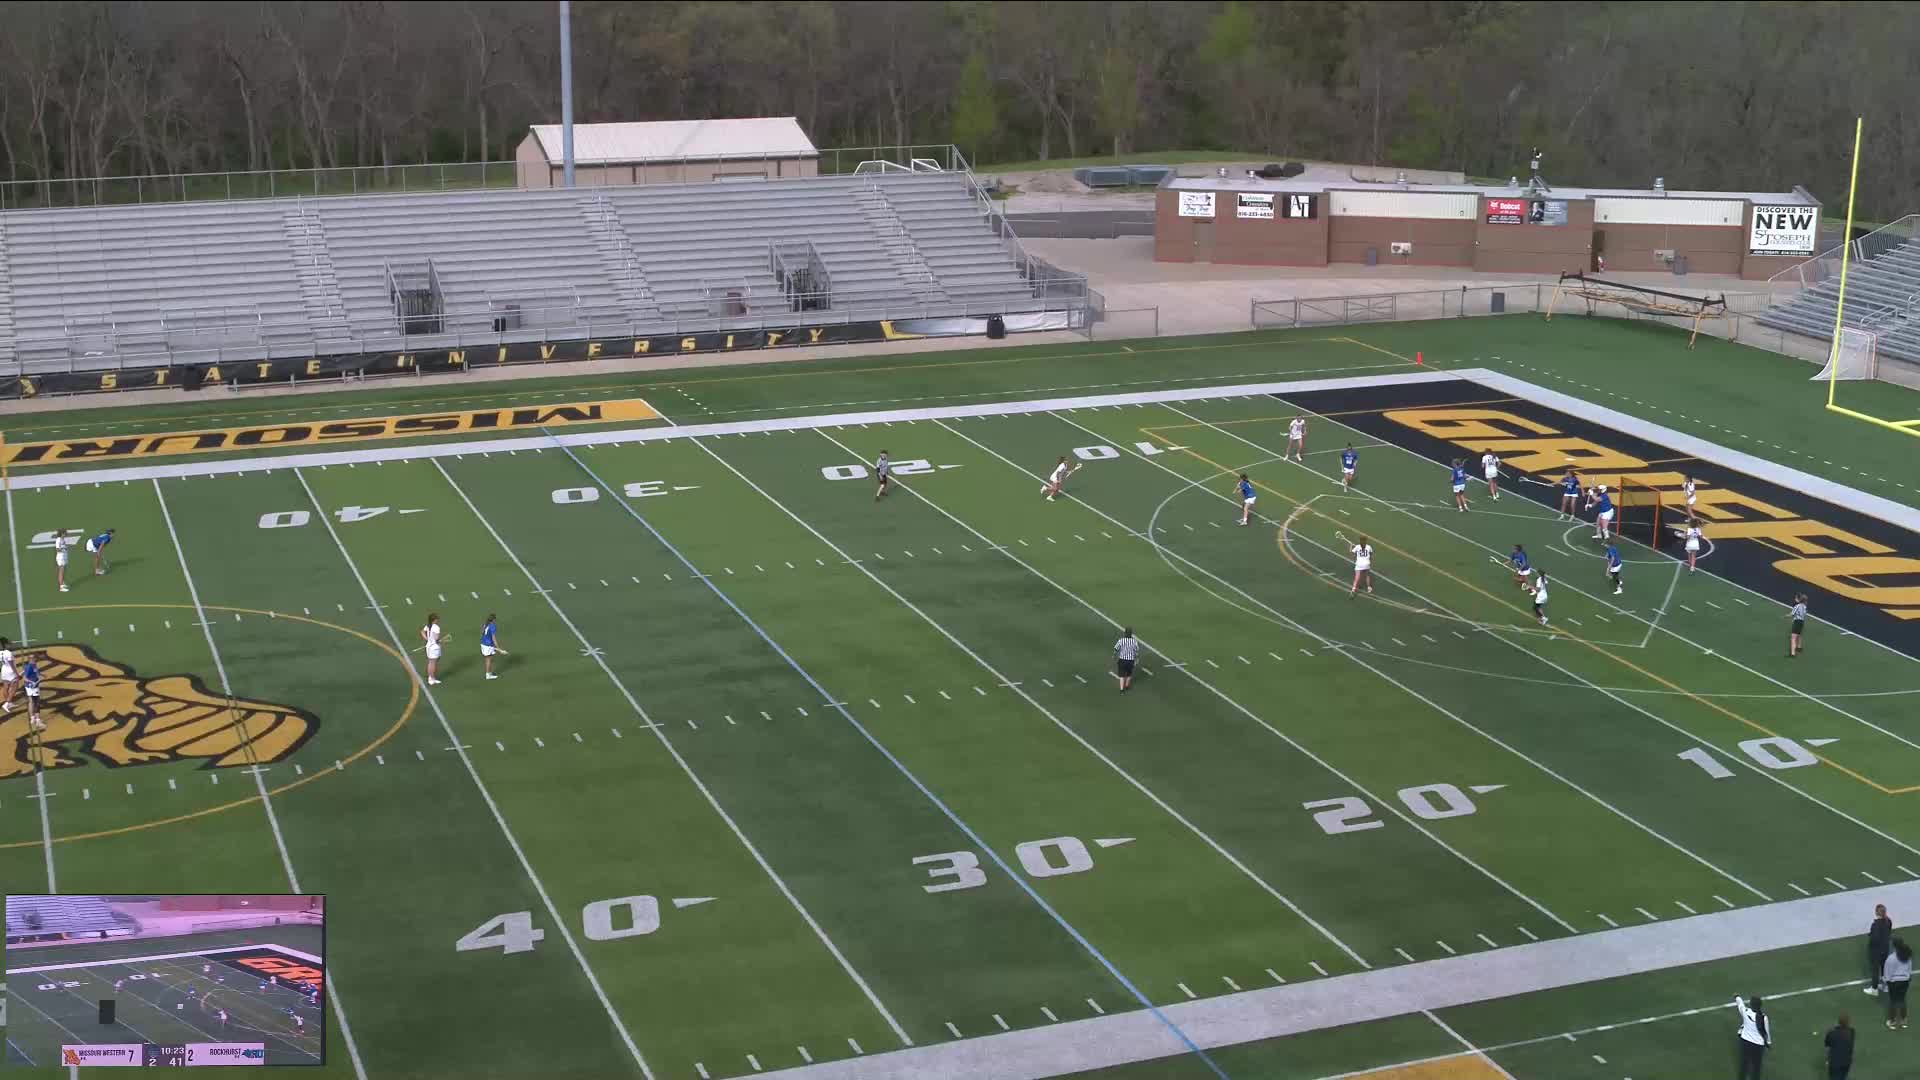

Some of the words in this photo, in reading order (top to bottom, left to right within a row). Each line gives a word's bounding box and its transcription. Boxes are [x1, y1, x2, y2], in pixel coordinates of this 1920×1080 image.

[1755, 213, 1813, 230] NEW
[1756, 206, 1796, 214] DISCOVER
[100, 359, 321, 390] STATE
[10, 404, 602, 466] MISSOURI
